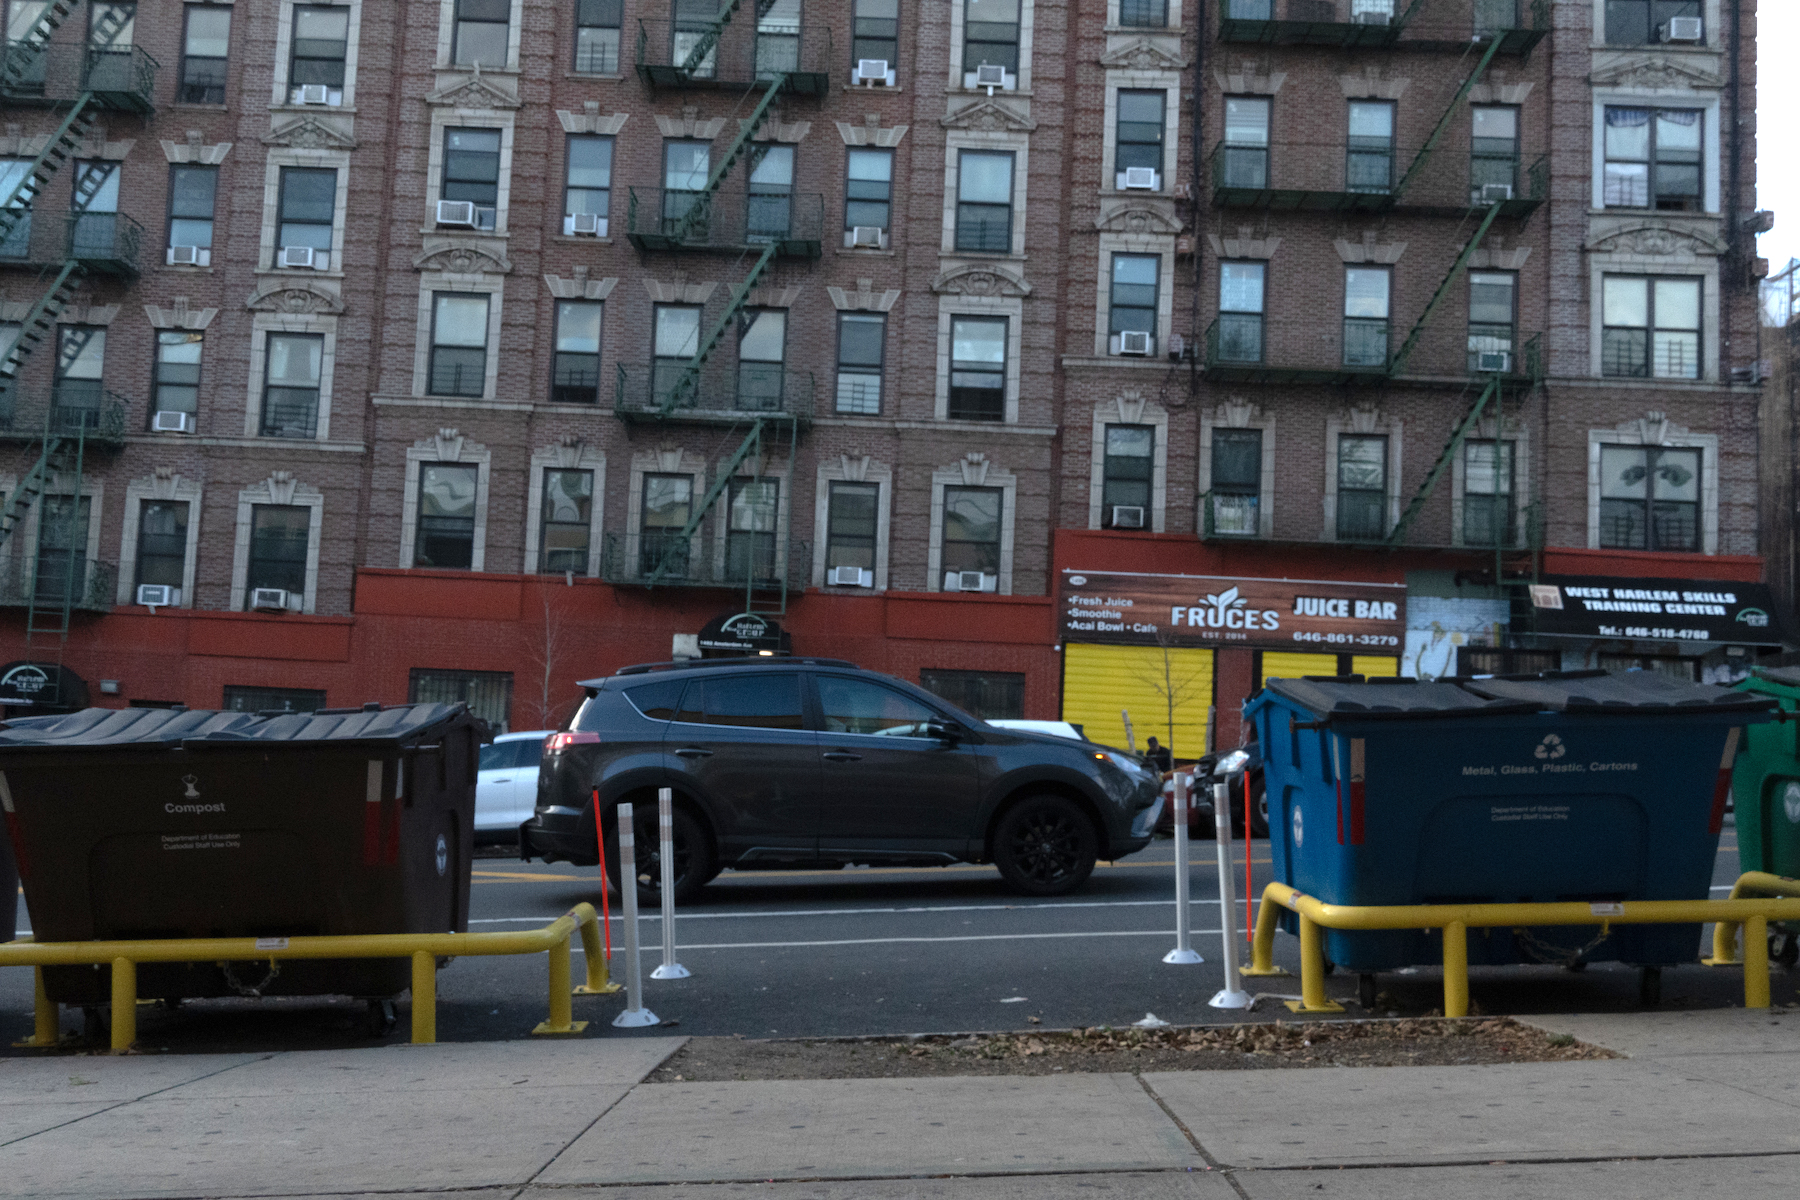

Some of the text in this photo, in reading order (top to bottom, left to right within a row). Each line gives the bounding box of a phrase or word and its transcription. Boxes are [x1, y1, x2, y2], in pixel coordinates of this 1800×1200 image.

[1072, 595, 1133, 607] Fresh Juice
[1564, 586, 1737, 604] WEST HARLEM SKILLS
[1072, 608, 1122, 619] Smoothie
[1293, 596, 1397, 620] JUICE BAR
[1582, 600, 1726, 616] TRAINING CENTER
[1171, 604, 1280, 631] FRUCES
[1071, 620, 1095, 631] Acai
[1097, 621, 1124, 632] Bowl
[1598, 625, 1623, 636] Tel.:
[1292, 631, 1398, 646] 646-861-3279
[1462, 761, 1638, 777] Metal, Glass, Plastic, Cartons
[165, 803, 226, 814] Compost
[161, 834, 200, 843] Department
[208, 833, 241, 841] Education
[163, 842, 194, 850] Custodial
[195, 841, 211, 849] Staff
[225, 840, 241, 849] Only
